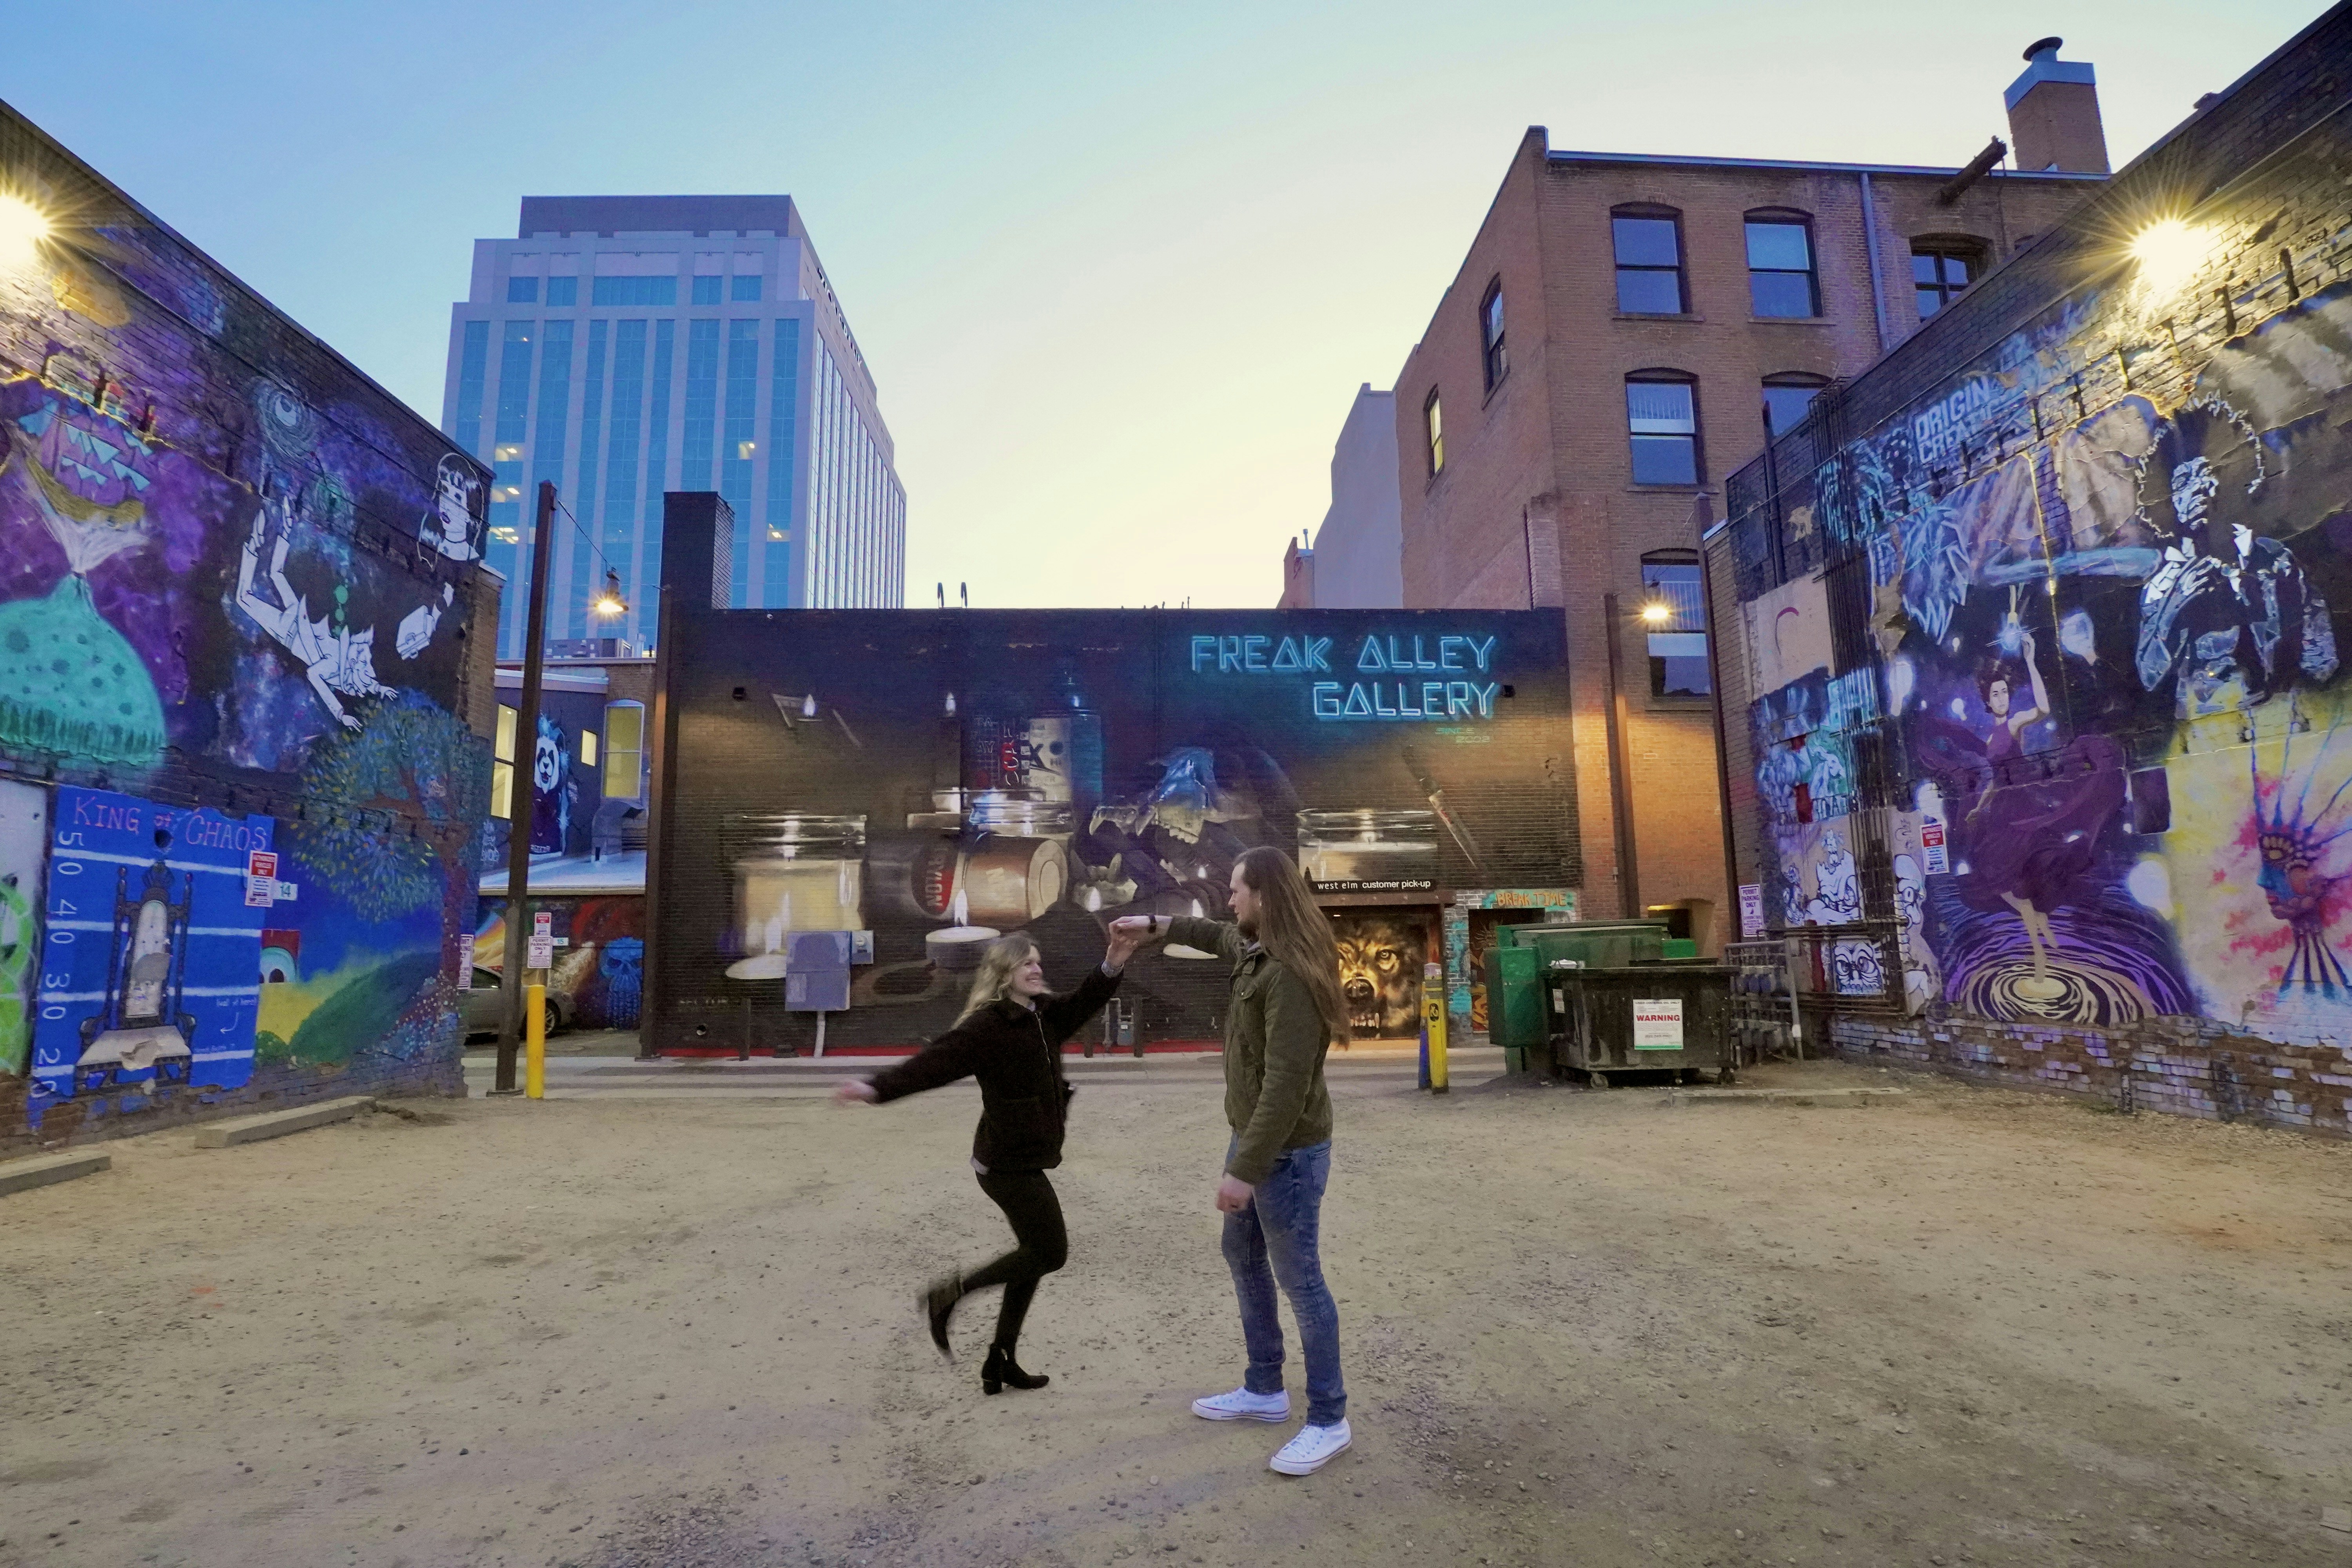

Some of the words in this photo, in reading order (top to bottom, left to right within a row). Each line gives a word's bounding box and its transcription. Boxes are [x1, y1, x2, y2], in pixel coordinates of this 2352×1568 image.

[1192, 635, 1330, 671] FREAK
[1357, 635, 1495, 671] ALLEY
[1313, 681, 1496, 719] GALLERY
[74, 796, 141, 835] KING
[185, 815, 266, 851] CHAOS
[279, 883, 291, 897] 14
[1401, 880, 1431, 889] pick-up
[1496, 892, 1531, 906] BREAK
[1534, 892, 1566, 906] TIME
